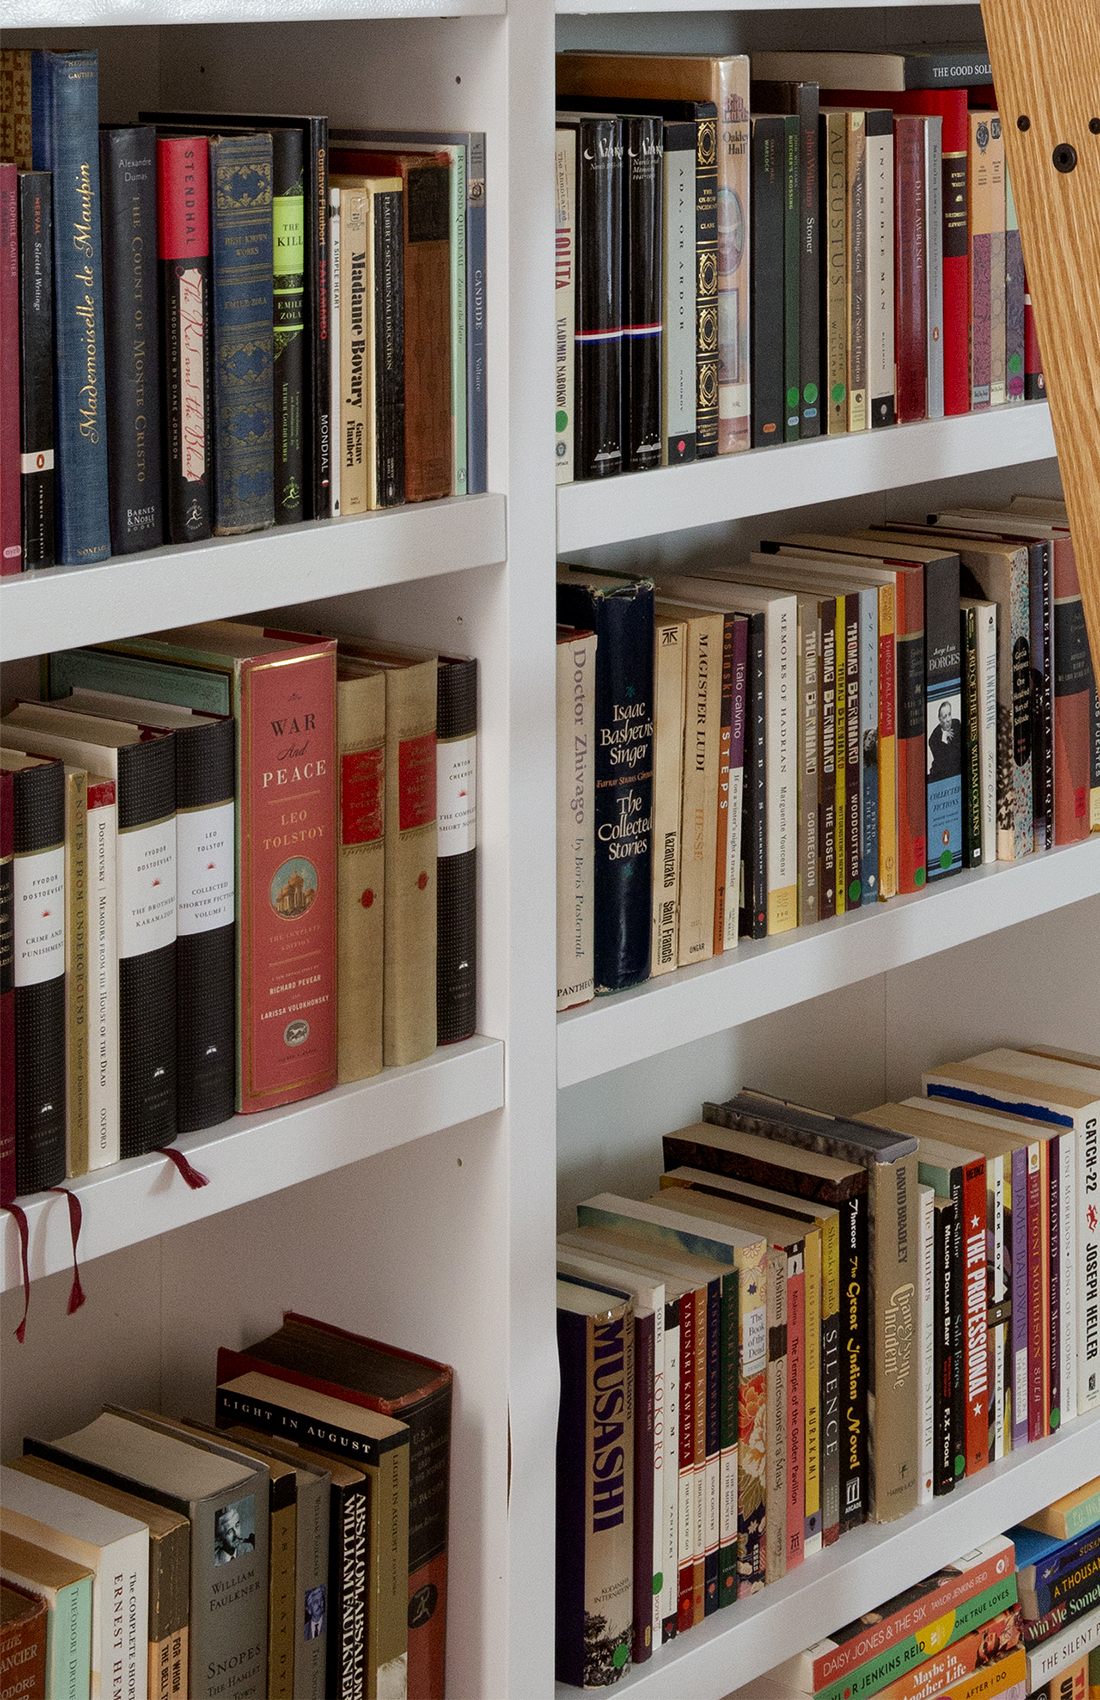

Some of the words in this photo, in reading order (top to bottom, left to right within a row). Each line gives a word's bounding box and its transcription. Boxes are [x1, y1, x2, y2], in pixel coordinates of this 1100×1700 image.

[933, 68, 948, 77] THE
[950, 66, 973, 76] GOOD
[72, 161, 94, 256] Maupin
[185, 151, 194, 245] STENDHAL
[831, 130, 842, 286] AUGUSTUS
[84, 265, 94, 287] de
[351, 252, 366, 336] Madame
[78, 295, 99, 445] Mademoiselle
[350, 337, 364, 408] Bovary
[321, 414, 329, 474] MONDIAL
[573, 649, 587, 727] Doctor
[698, 633, 708, 725] MAGISTER
[271, 713, 317, 738] WAR
[600, 721, 653, 747] Bashevis
[612, 702, 646, 722] Isaac
[262, 760, 327, 787] PEACE
[610, 743, 648, 768] Singer
[695, 731, 706, 772] LUDI
[572, 734, 588, 825] Zhivago
[280, 810, 308, 827] LEO
[617, 790, 642, 814] The
[262, 827, 326, 850] TOLSTOY
[574, 838, 583, 851] by
[598, 814, 652, 841] Collected
[608, 838, 647, 860] Stories
[850, 794, 858, 877] WOODCUTTERS
[575, 856, 583, 890] Boris
[664, 831, 676, 888] Kazantzakis
[575, 896, 584, 958] Pasternak
[663, 901, 674, 926] Saint
[662, 928, 672, 964] Francis
[1085, 1117, 1096, 1194] CATCH-22
[968, 1229, 985, 1264] THE
[1086, 1243, 1097, 1301] JOSEPH
[968, 1266, 986, 1402] PROFESSIONAL
[1086, 1307, 1097, 1361] HELLER
[826, 1329, 837, 1459] SILENCE
[223, 1398, 273, 1420] LIGHT
[281, 1416, 299, 1429] IN
[307, 1426, 372, 1453] AUGUST
[592, 1308, 623, 1534] MUSASHI
[654, 1372, 663, 1470] KOKORO
[210, 1581, 261, 1611] FAULKNER
[211, 1570, 255, 1594] WILLIAM
[1054, 1583, 1061, 1597] A
[113, 1573, 123, 1650] ERNEST
[955, 1615, 970, 1628] ONE
[971, 1605, 987, 1618] TRUE
[988, 1590, 1010, 1608] LOVES
[1029, 1619, 1050, 1640] Win
[1051, 1610, 1068, 1628] Me
[207, 1644, 261, 1678] SNOPES
[823, 1652, 850, 1677] DAISY
[852, 1632, 885, 1663] JONES
[885, 1626, 894, 1638] &
[894, 1618, 913, 1633] THE
[912, 1608, 927, 1624] SIX
[1041, 1652, 1060, 1673] THE
[1061, 1629, 1093, 1657] SILENT
[862, 1658, 901, 1690] JENKINS
[902, 1641, 925, 1666] REID
